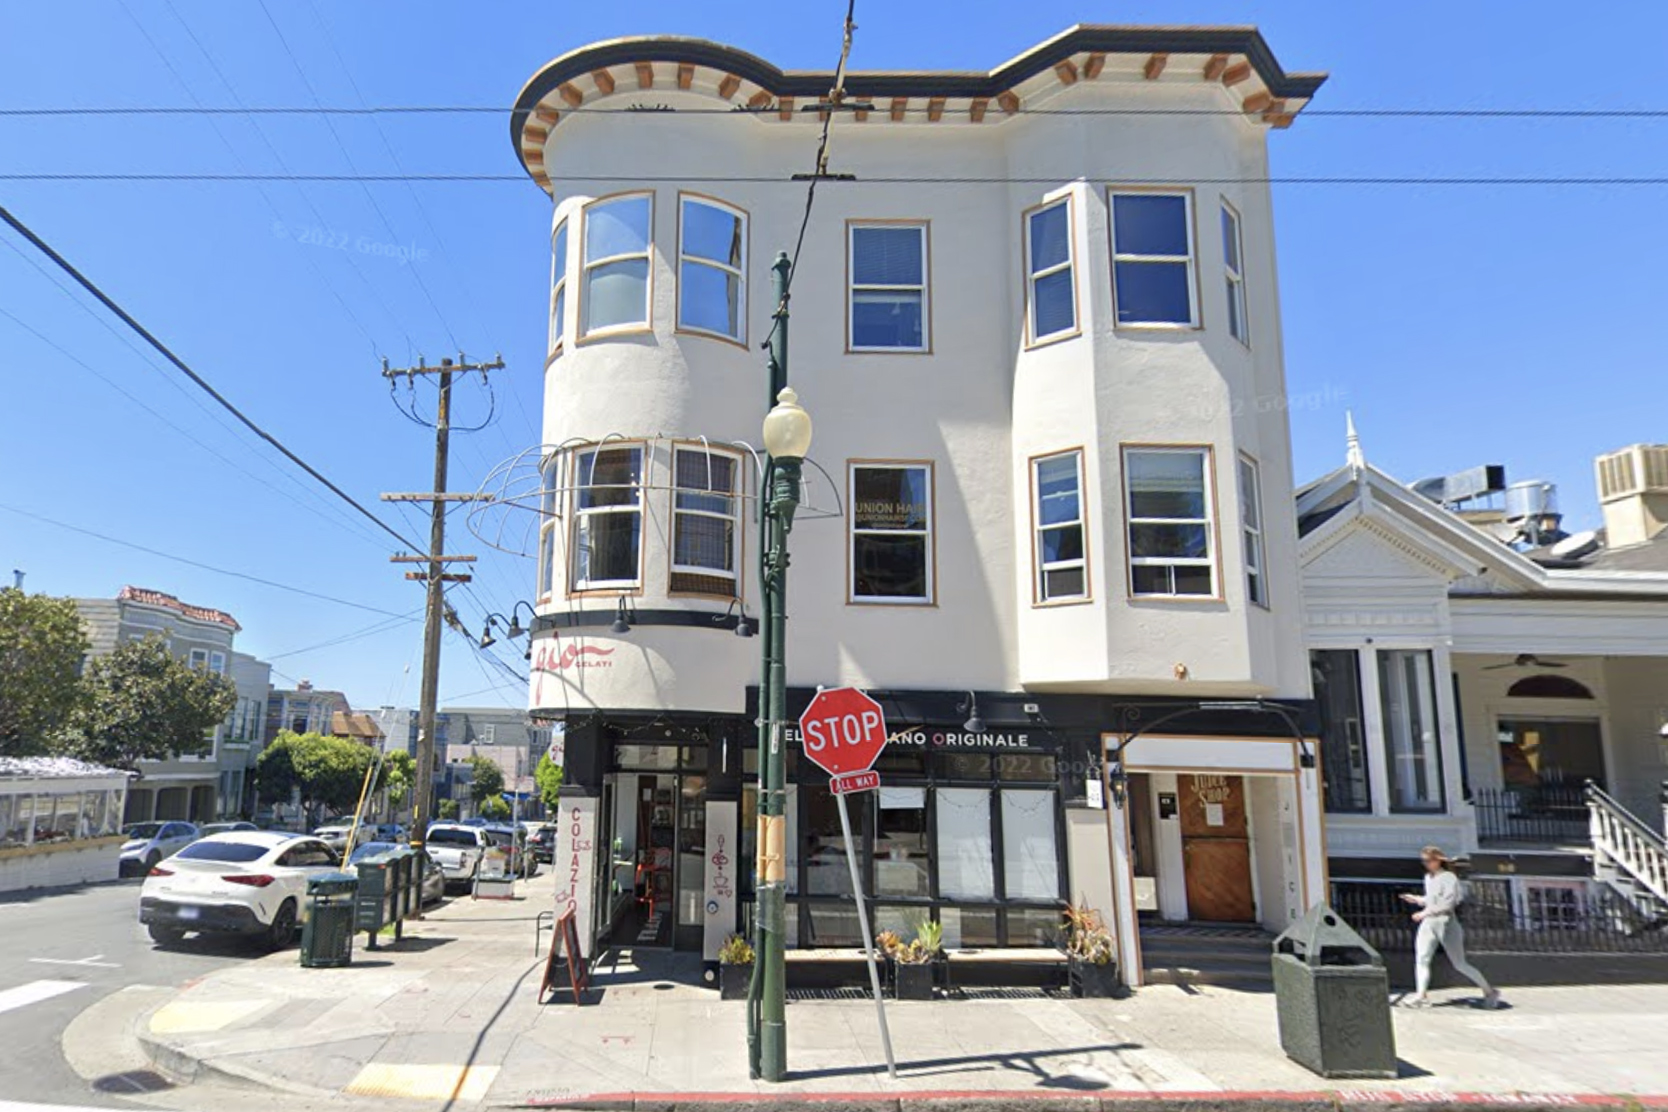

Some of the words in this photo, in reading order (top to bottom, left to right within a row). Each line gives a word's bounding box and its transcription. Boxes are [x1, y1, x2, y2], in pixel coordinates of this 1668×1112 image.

[855, 503, 893, 513] UNION
[806, 710, 880, 751] STOP
[932, 733, 1029, 747] ORIGINALE
[834, 777, 853, 791] ALL
[856, 775, 876, 789] WAY
[567, 807, 581, 913] COLAZIO
